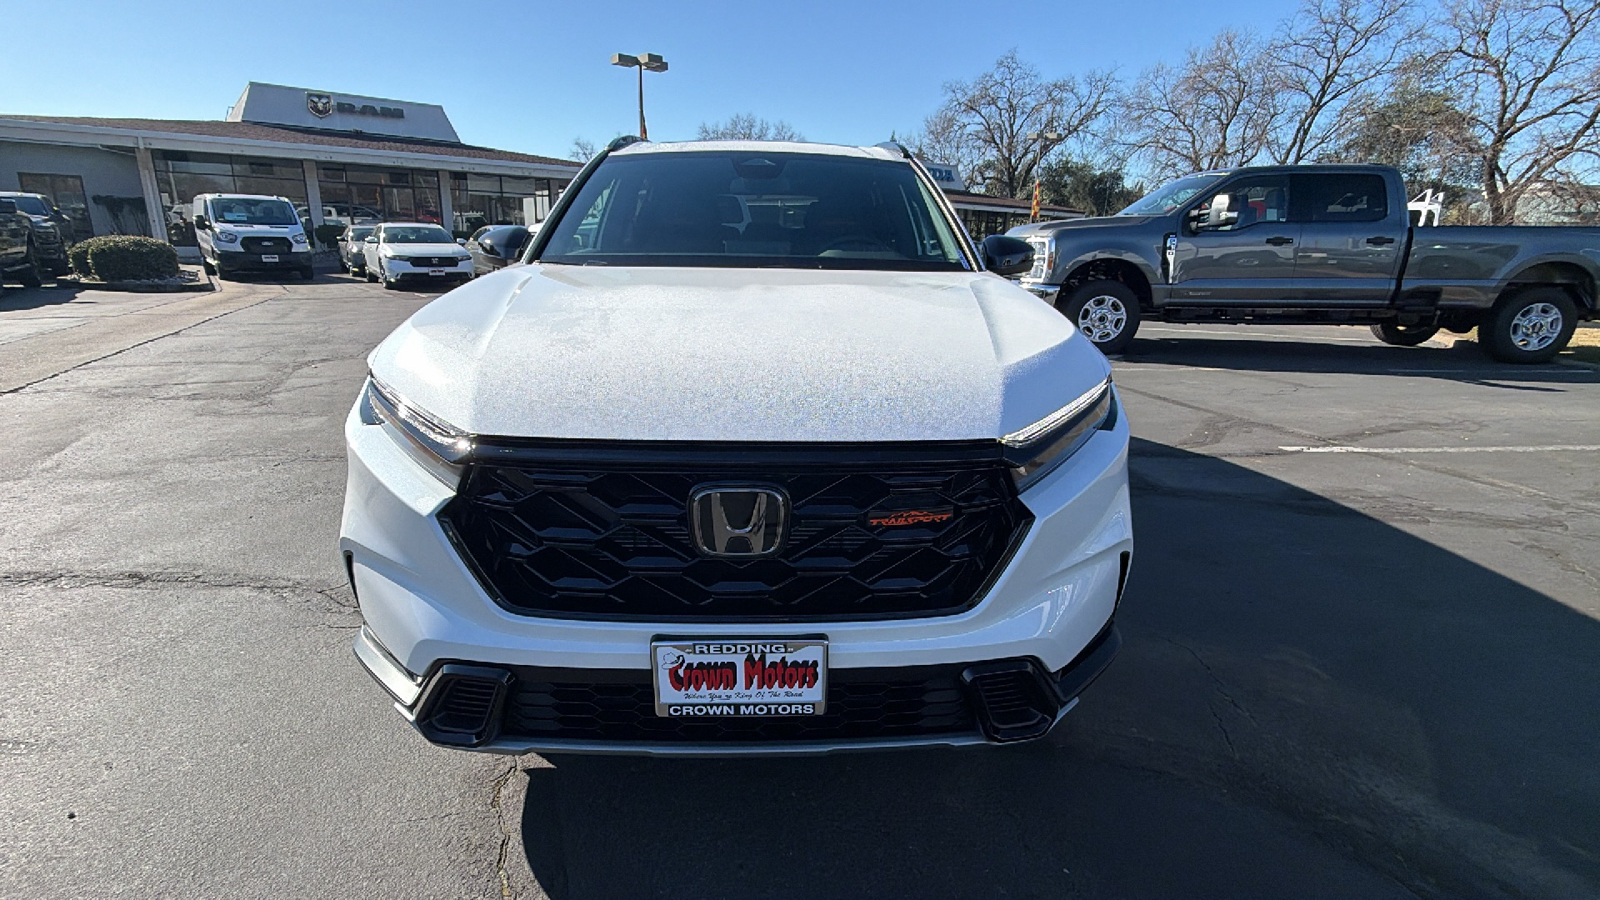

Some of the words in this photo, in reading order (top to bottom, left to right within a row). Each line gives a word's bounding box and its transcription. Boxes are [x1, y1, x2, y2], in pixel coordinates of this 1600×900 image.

[336, 102, 405, 119] RAM
[926, 167, 955, 182] DA
[869, 513, 952, 526] TRAILSPORT
[695, 644, 786, 654] REDDING
[668, 655, 737, 692] Crown
[743, 653, 819, 690] Motors
[734, 692, 752, 700] King
[755, 691, 765, 699] Of
[784, 690, 804, 698] Road
[669, 705, 735, 716] CROWN
[740, 704, 814, 715] MOTORS
